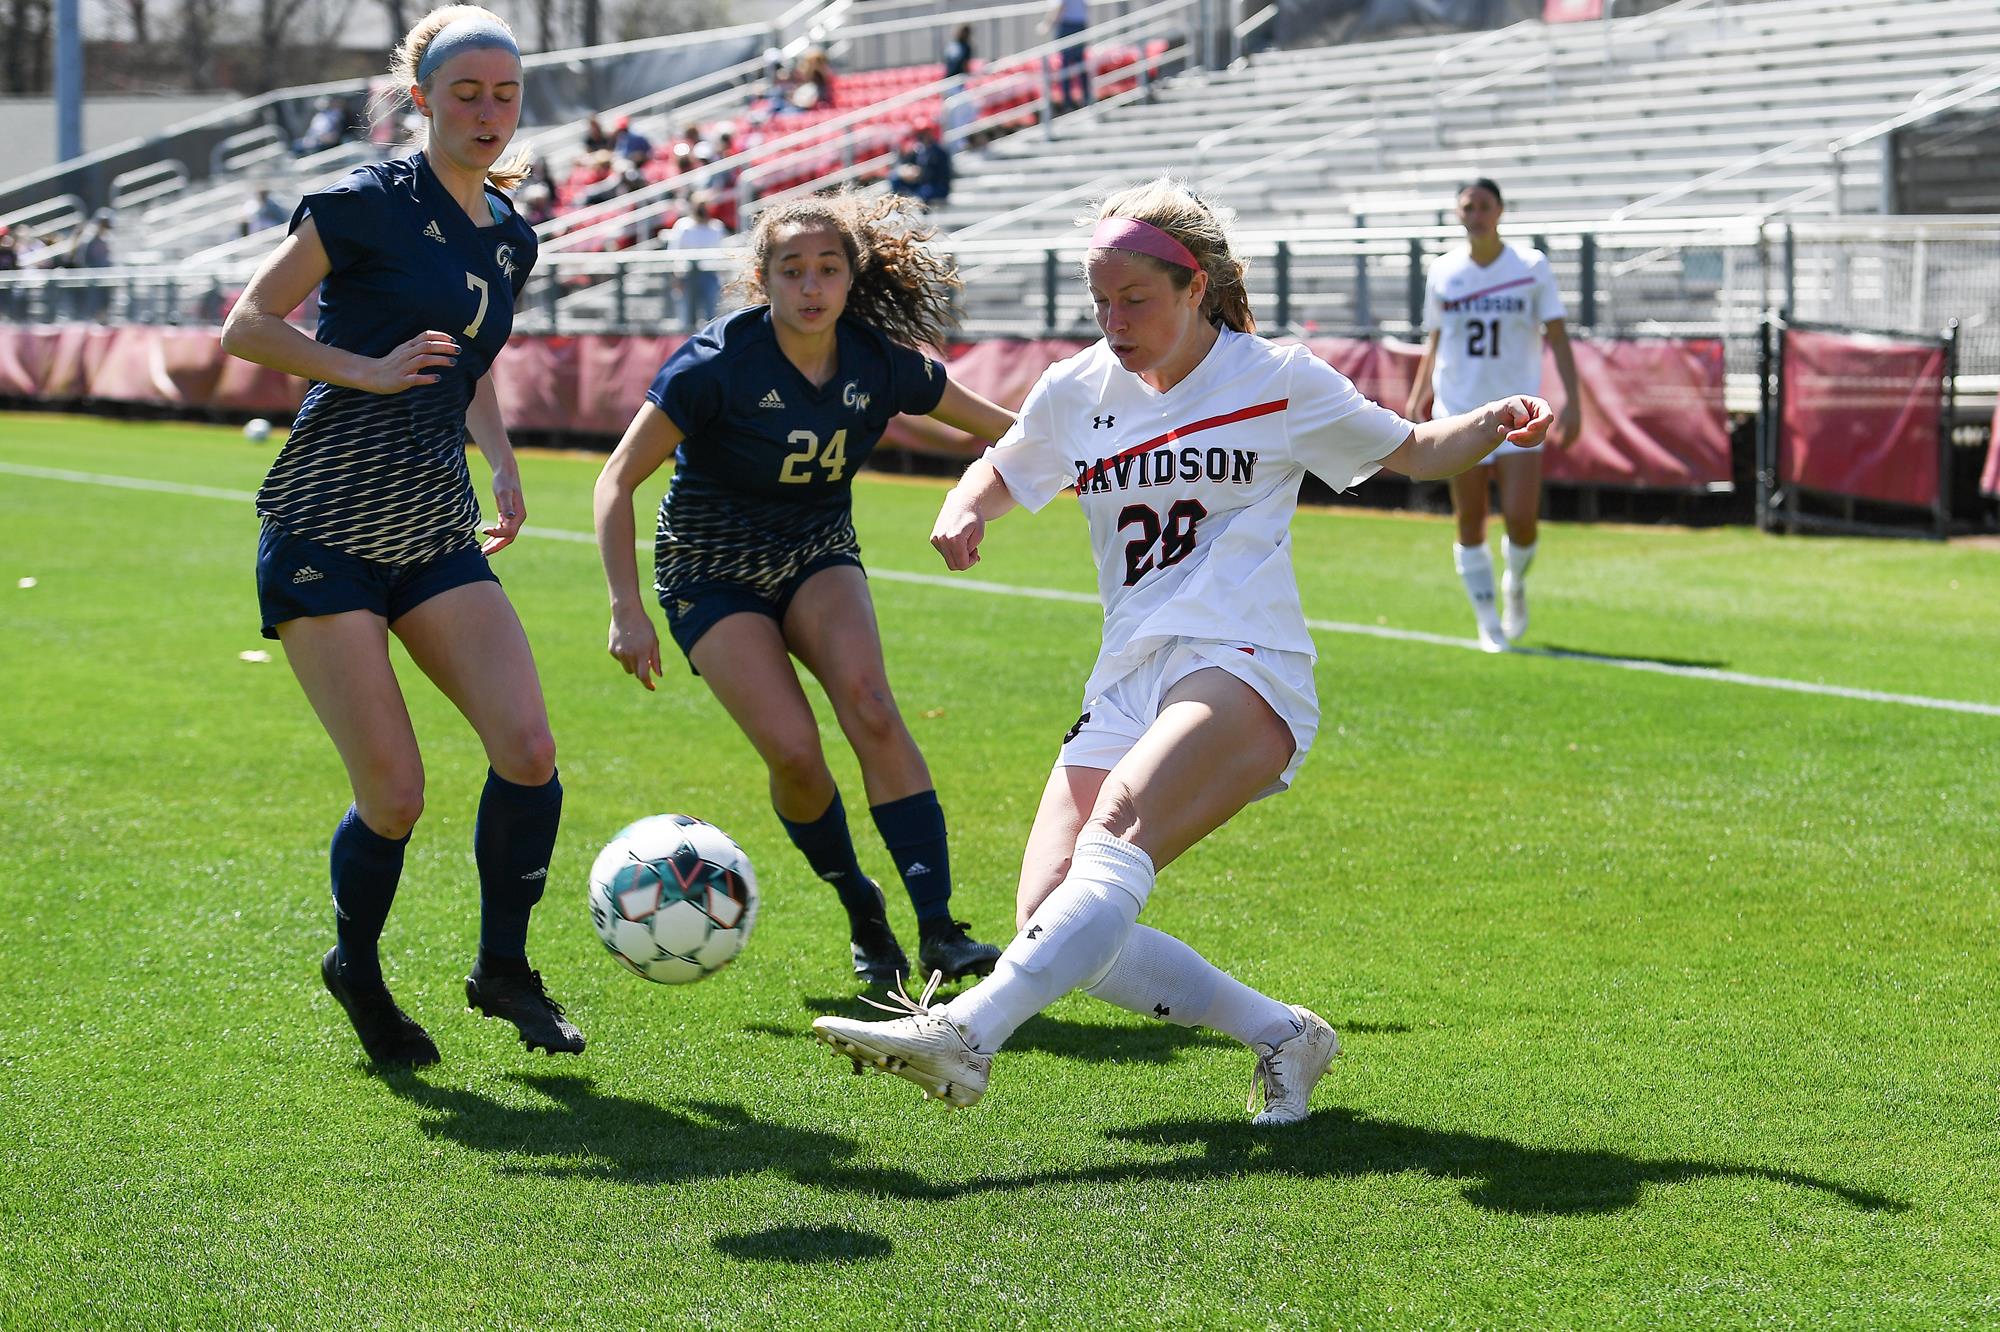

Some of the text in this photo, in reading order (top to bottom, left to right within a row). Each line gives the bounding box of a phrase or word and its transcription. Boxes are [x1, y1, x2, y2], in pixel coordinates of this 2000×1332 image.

[423, 229, 447, 243] adas
[463, 271, 488, 339] 7
[1466, 319, 1499, 358] 21
[759, 400, 785, 409] adidas
[778, 429, 848, 483] 24
[1075, 448, 1258, 494] DAVIDSON
[1117, 499, 1207, 586] 28
[292, 572, 324, 584] adidas
